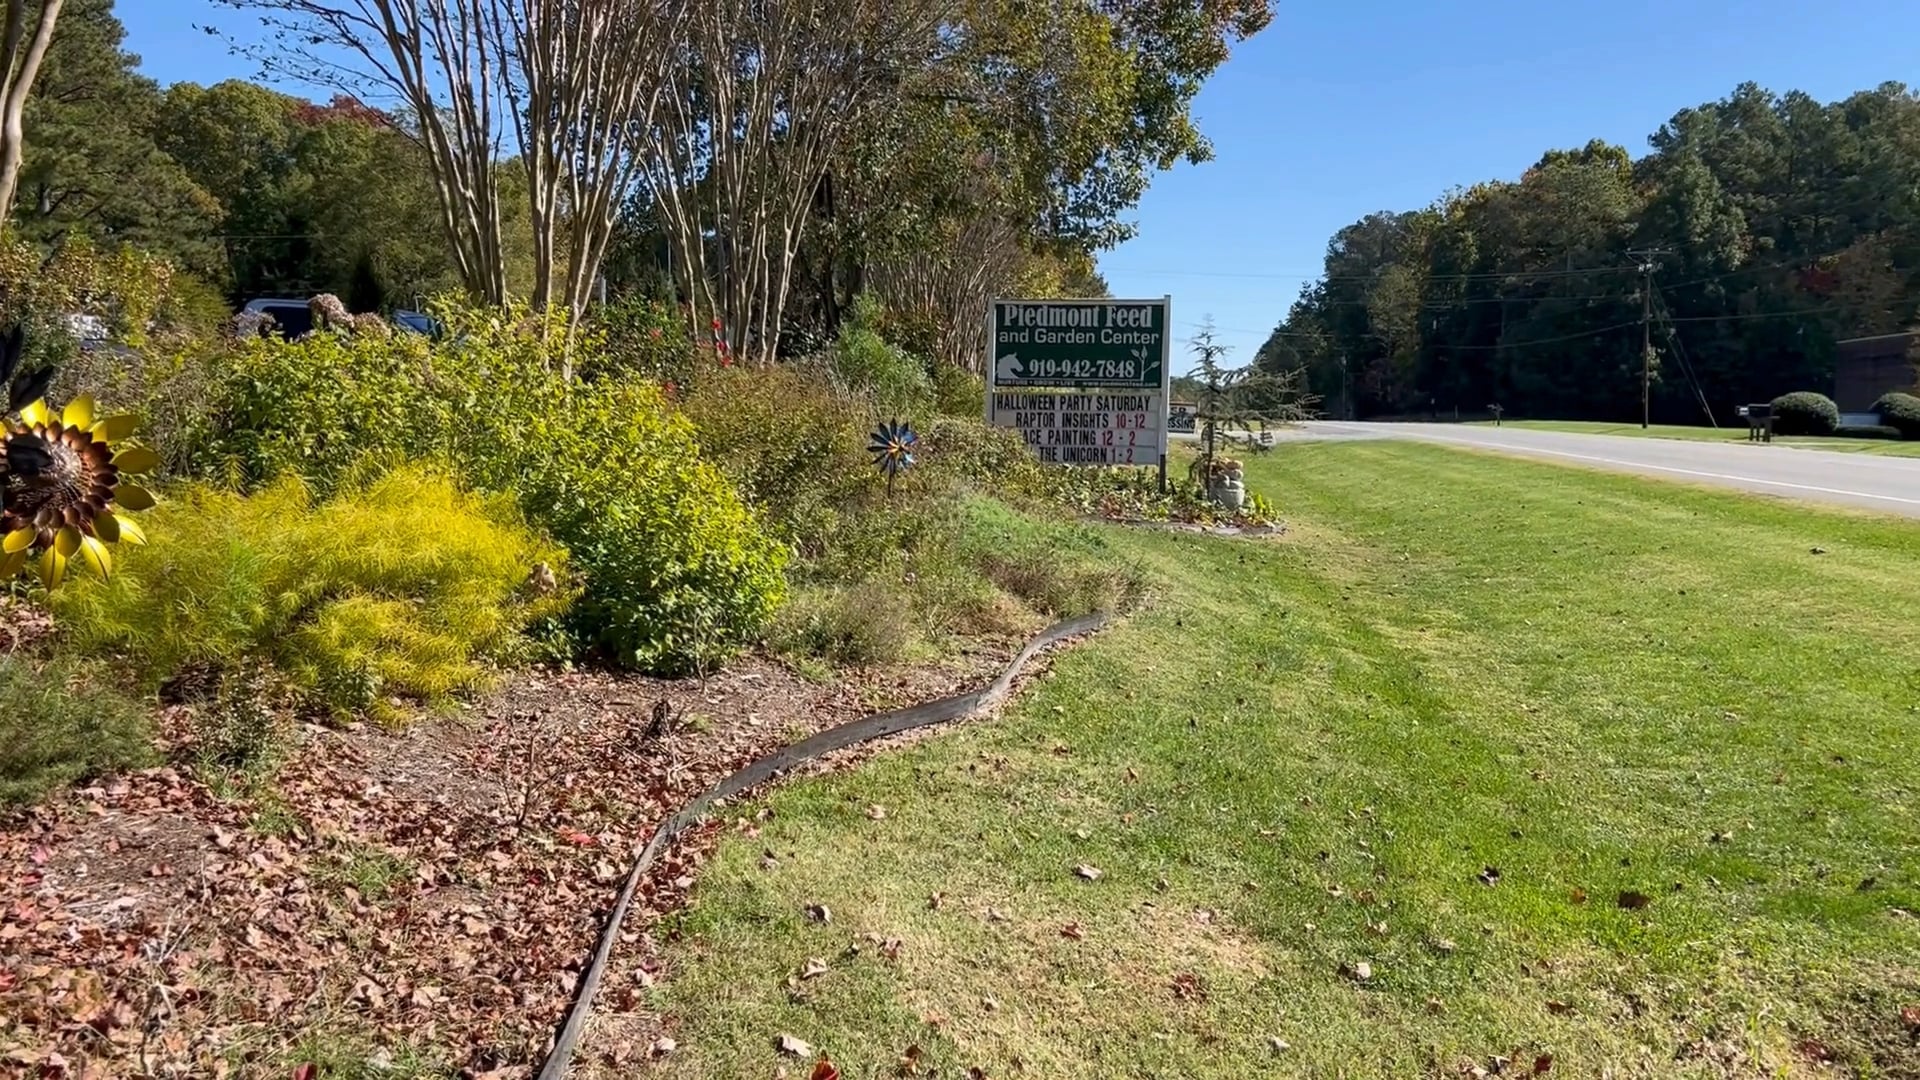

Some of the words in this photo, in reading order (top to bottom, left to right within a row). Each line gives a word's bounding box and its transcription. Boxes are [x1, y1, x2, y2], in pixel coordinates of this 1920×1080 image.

[1004, 304, 1099, 327] Piedmont
[1106, 305, 1152, 328] Feed
[1000, 329, 1028, 343] and
[1034, 328, 1095, 344] Garden
[1101, 329, 1158, 345] Center
[1029, 359, 1135, 378] 919-942-7848
[997, 395, 1055, 410] HALLOWEEN
[1060, 395, 1092, 410] PARTY
[1096, 395, 1150, 411] SATURDAY
[1016, 413, 1056, 428] RAPTOR
[1062, 413, 1109, 428] INSIGHTS
[1020, 429, 1042, 444] ACE
[1049, 430, 1096, 445] PAINTING
[1102, 431, 1113, 445] 12
[1040, 447, 1057, 462] THE
[1063, 448, 1107, 462] UNICORN
